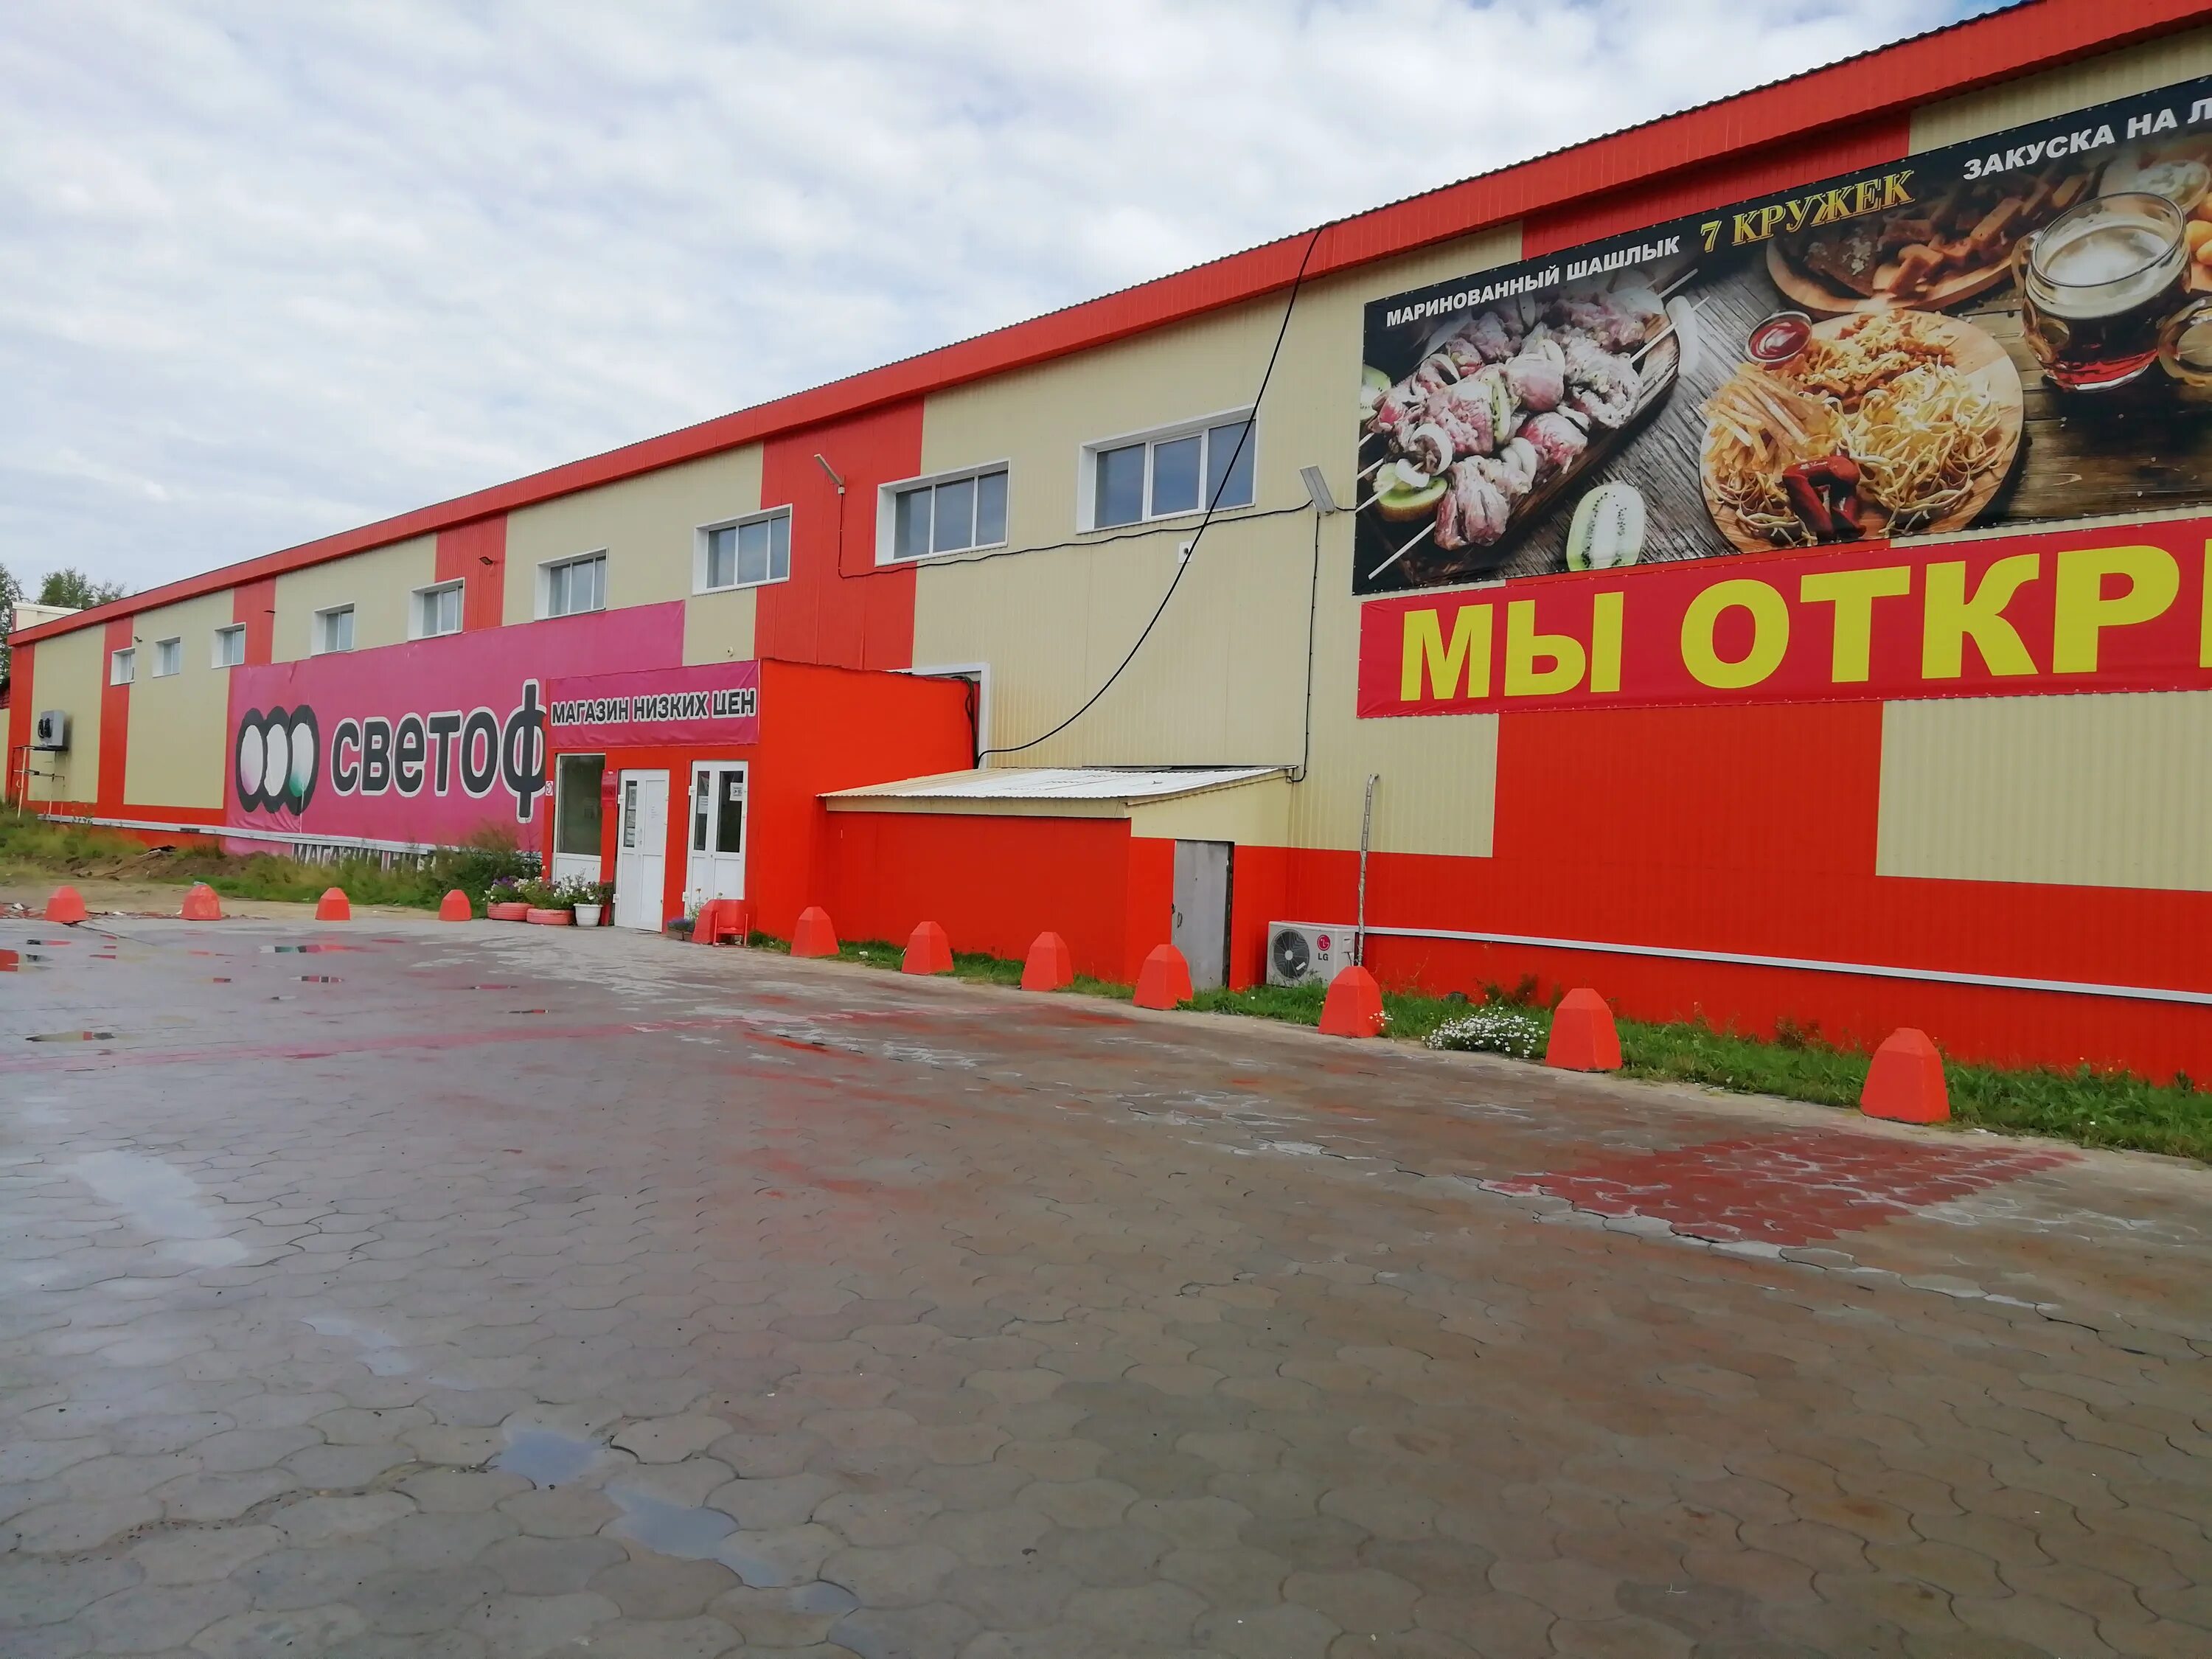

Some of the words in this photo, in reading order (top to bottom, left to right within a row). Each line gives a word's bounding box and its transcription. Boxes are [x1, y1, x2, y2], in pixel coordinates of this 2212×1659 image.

[1962, 124, 2115, 181] ЗАКУСКА
[2126, 108, 2177, 139] НА
[1700, 220, 1722, 253] 7
[1731, 170, 1916, 246] КРУЖЕК
[1386, 265, 1559, 327] МАРИНОВАННЫЙ
[1567, 235, 1680, 280] ШАШЛЫК
[1400, 591, 1624, 701] МЫ
[1680, 538, 2212, 688] ОТКР
[552, 698, 629, 724] МАГАЗИН
[633, 693, 708, 722] НИЗКИХ
[712, 689, 756, 717] ЦЕН
[1318, 952, 1329, 961] LG
